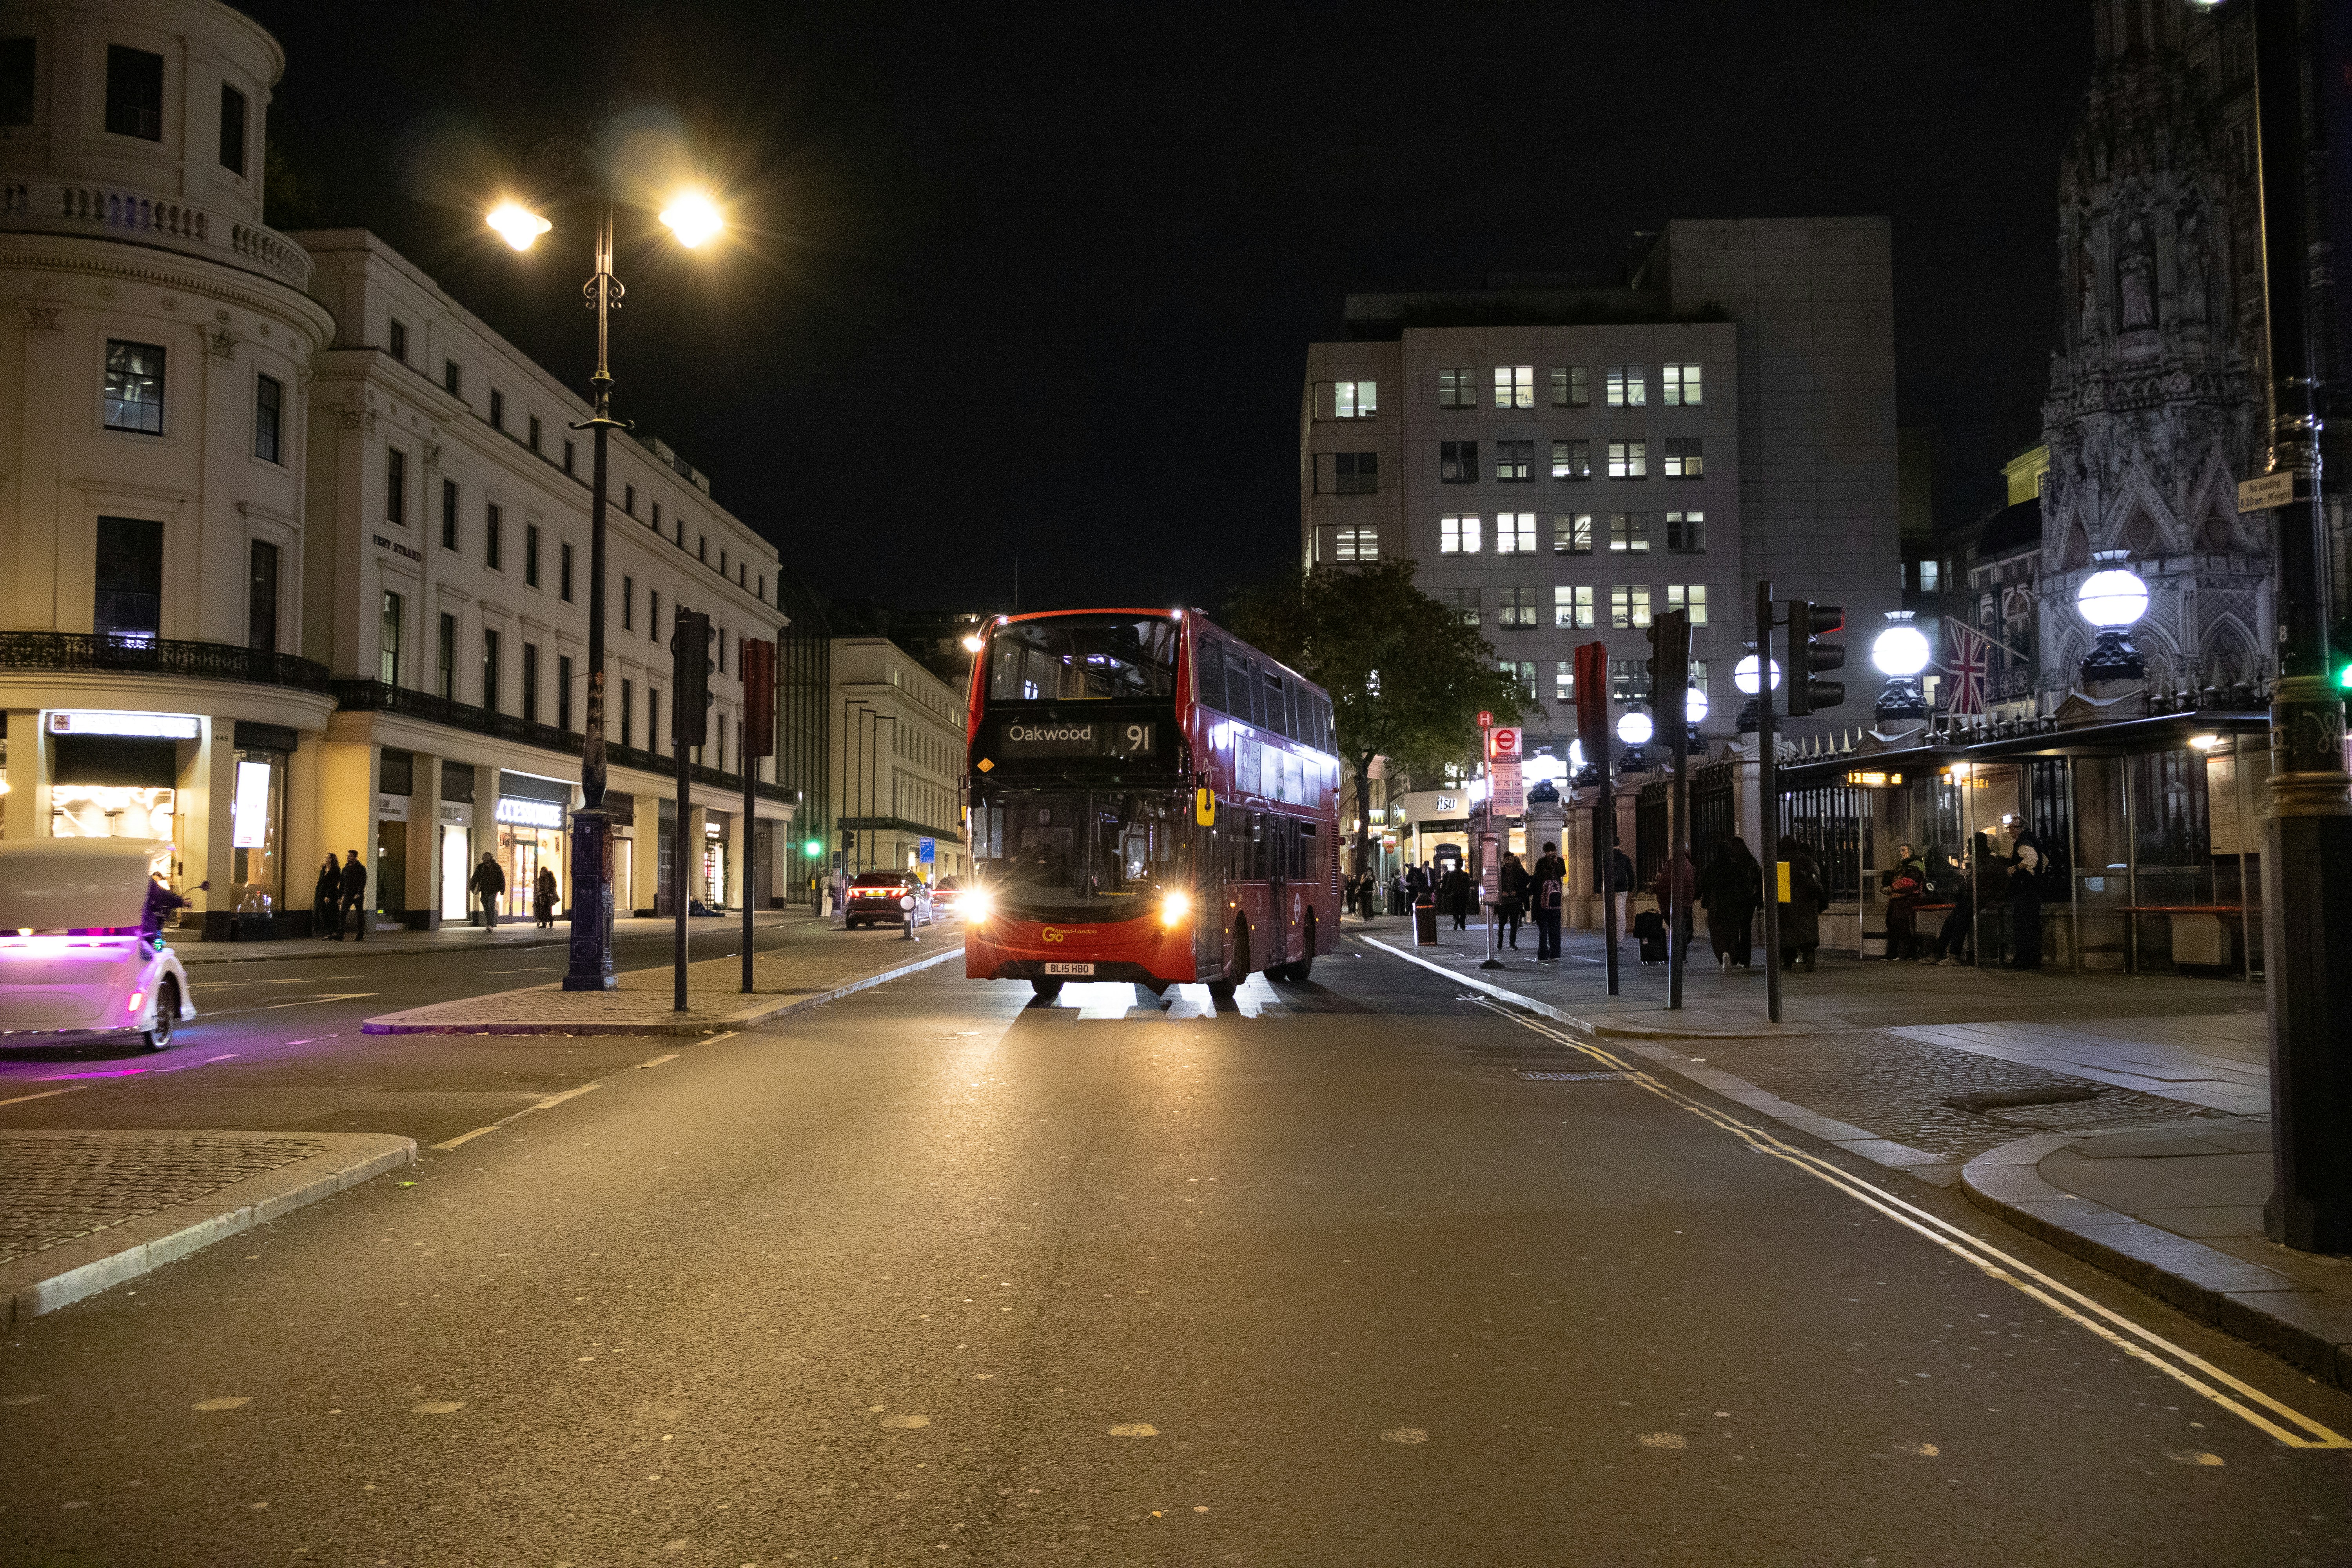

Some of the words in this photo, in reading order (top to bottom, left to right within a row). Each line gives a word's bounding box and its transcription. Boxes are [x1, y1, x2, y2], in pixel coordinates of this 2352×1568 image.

[1480, 714, 1490, 725] H
[1010, 724, 1091, 741] Oakwood
[1127, 725, 1149, 750] 91
[1437, 795, 1456, 809] itsu
[1042, 927, 1063, 942] Go
[1051, 964, 1069, 973] BL15
